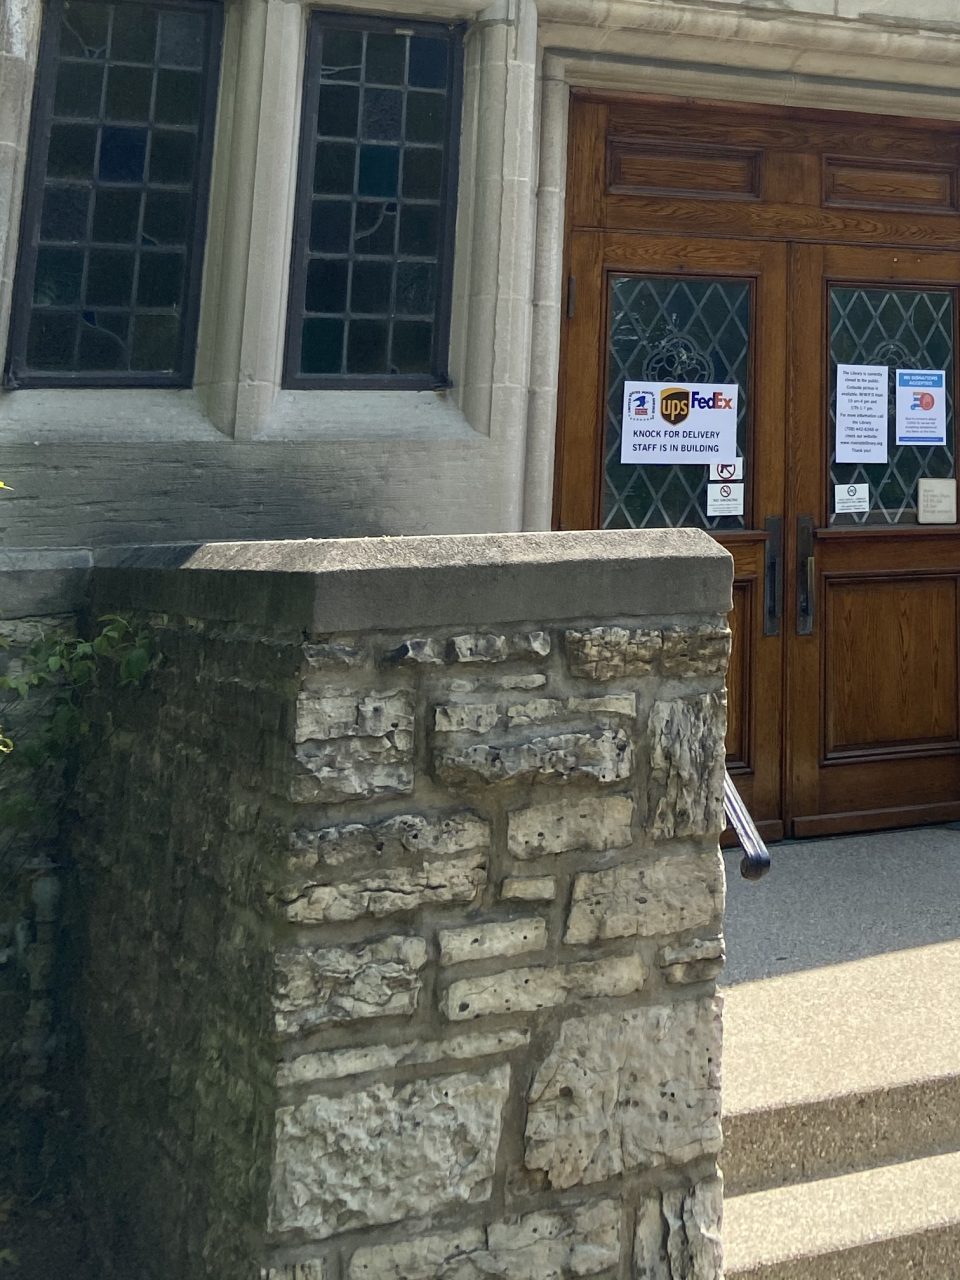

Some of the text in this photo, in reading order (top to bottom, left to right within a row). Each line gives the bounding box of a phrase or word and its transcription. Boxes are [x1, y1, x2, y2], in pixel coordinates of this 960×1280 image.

[691, 391, 733, 410] FedEx
[662, 400, 688, 421] ups
[633, 430, 720, 439] KNOCK FOR DELIVERY
[632, 443, 719, 453] STAFF IS IN BUILDING
